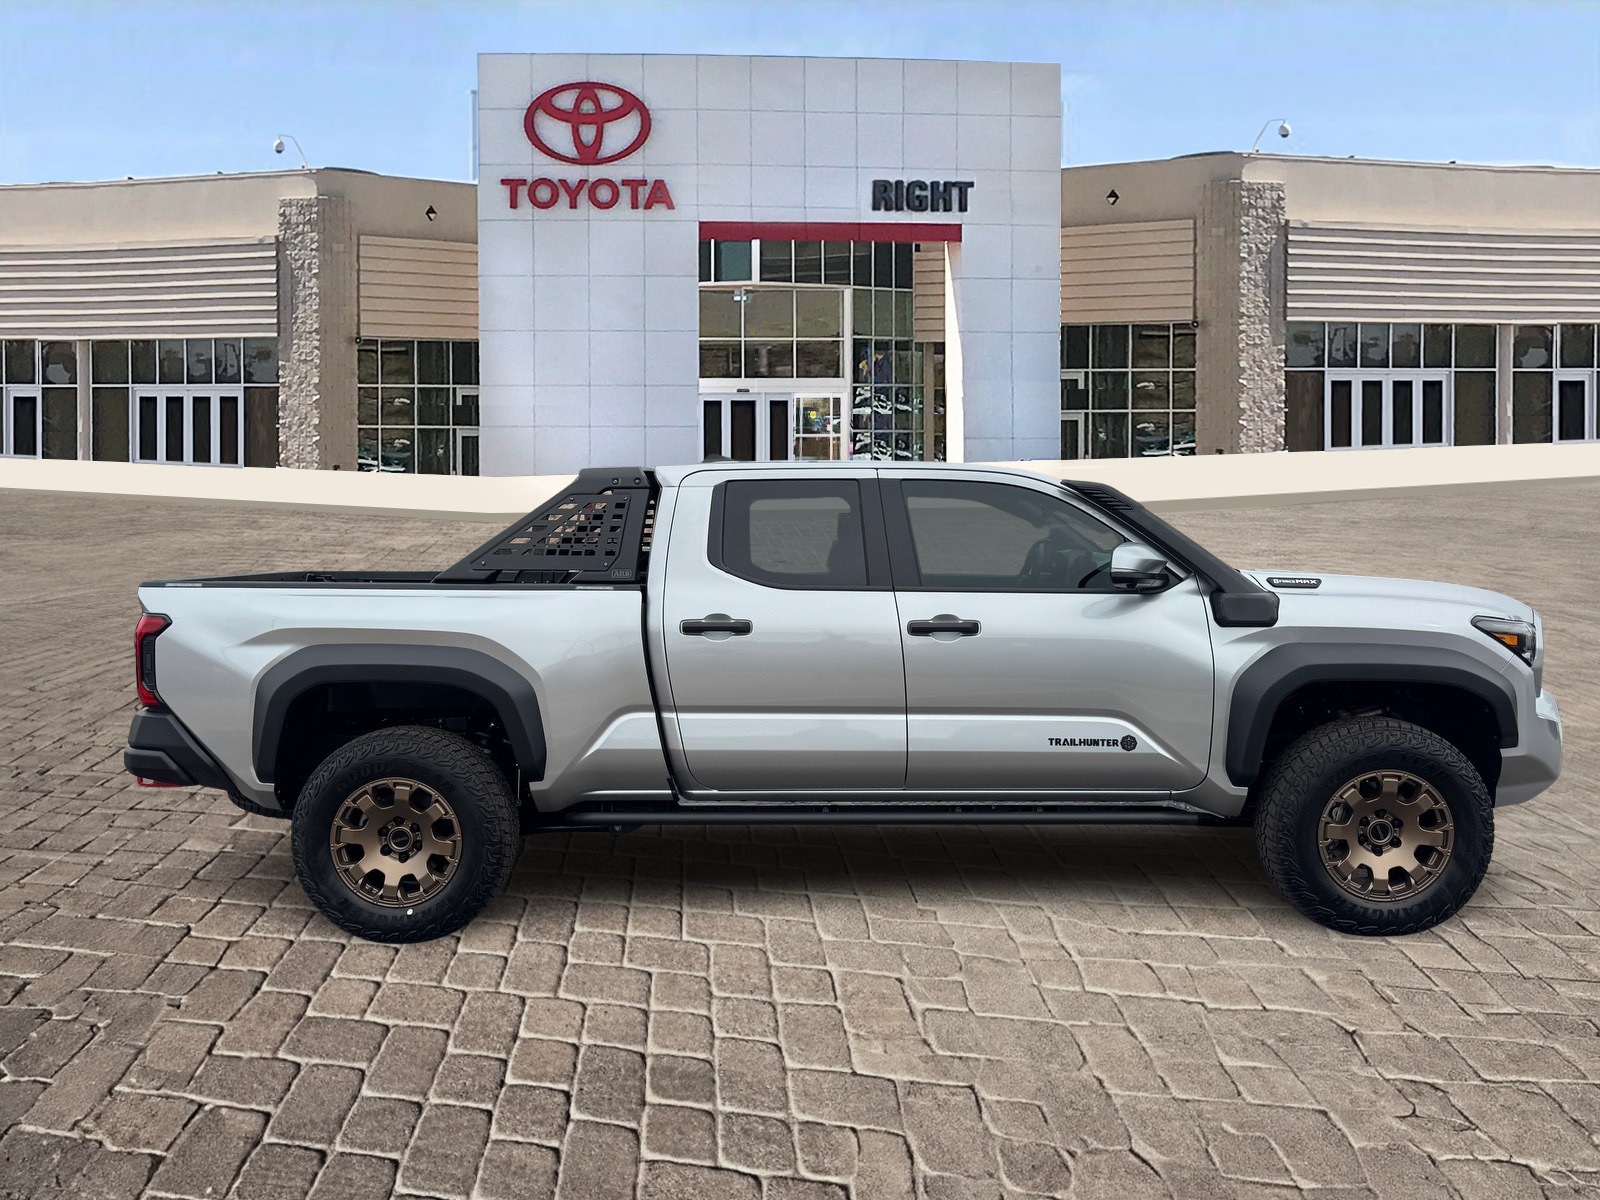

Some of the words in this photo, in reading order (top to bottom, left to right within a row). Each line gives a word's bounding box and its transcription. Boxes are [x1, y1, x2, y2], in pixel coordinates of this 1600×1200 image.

[500, 177, 675, 210] TOYOTA
[872, 179, 975, 212] RIGHT
[1048, 737, 1119, 747] TRAILHUNTER
